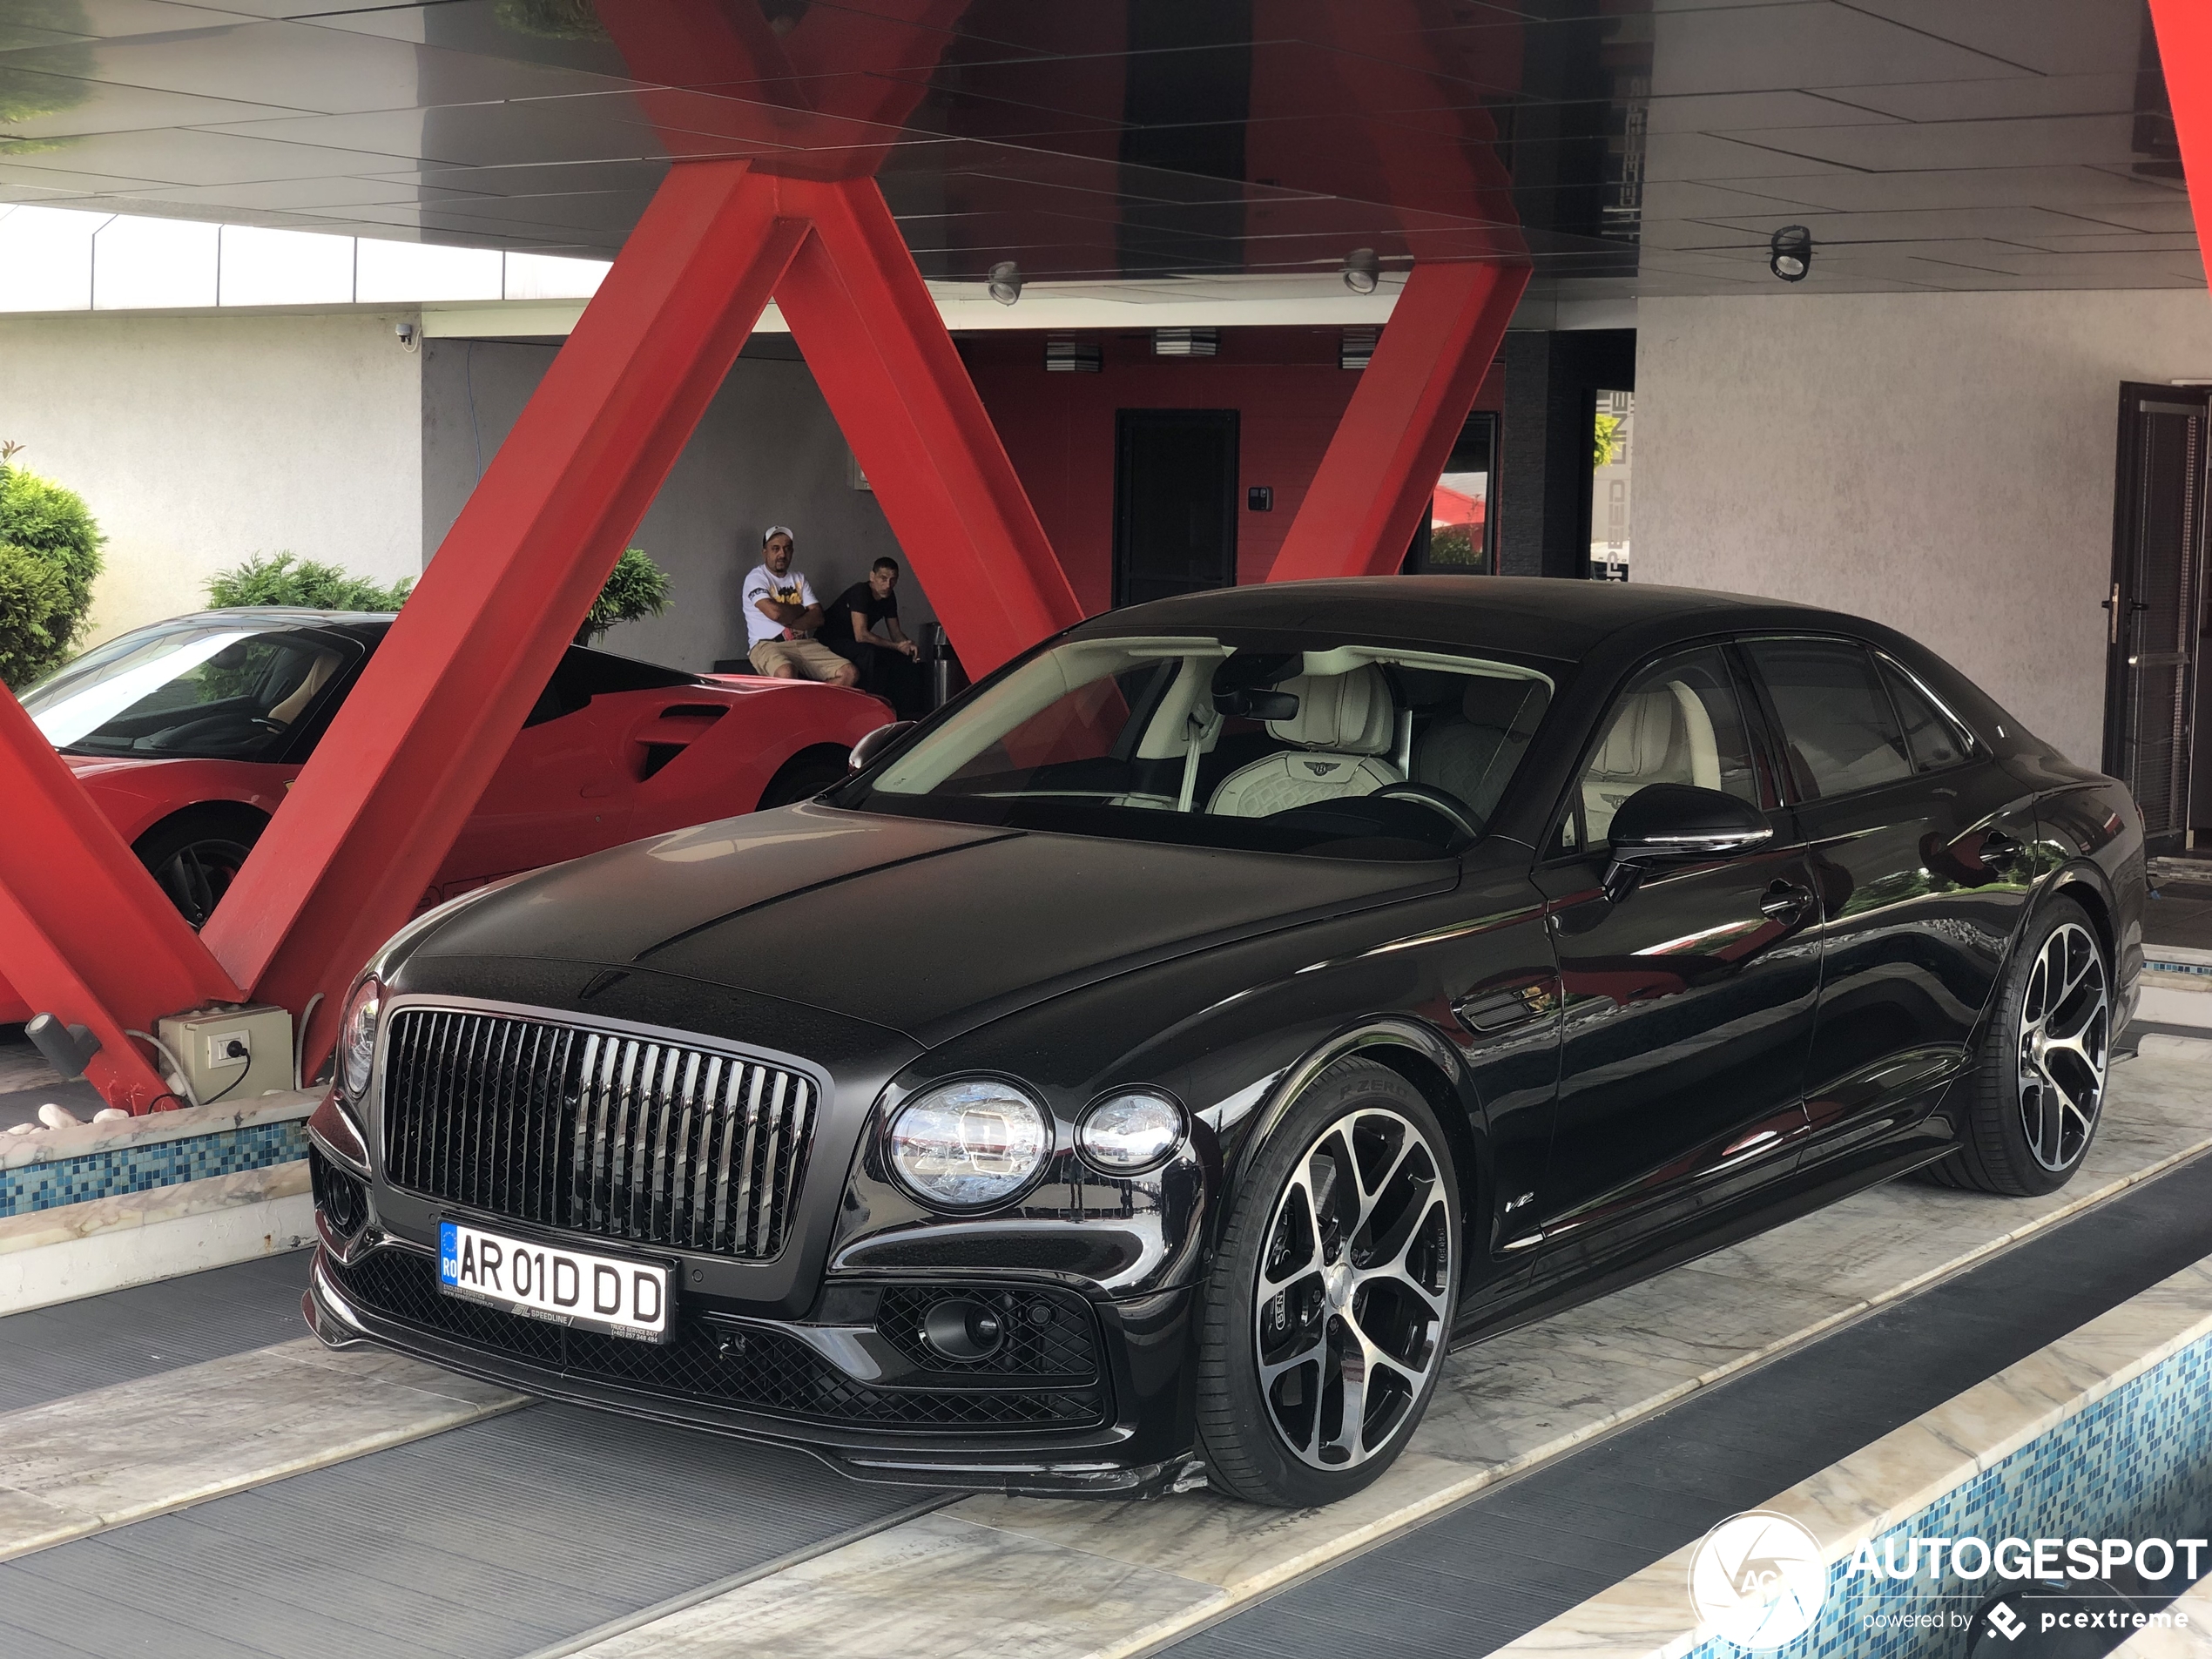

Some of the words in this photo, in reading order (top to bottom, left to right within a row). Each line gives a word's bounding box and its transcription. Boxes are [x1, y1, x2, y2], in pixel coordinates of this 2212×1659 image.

[1607, 479, 1626, 582] PEED
[443, 1257, 457, 1278] RO
[626, 1325, 645, 1336] SERVICE
